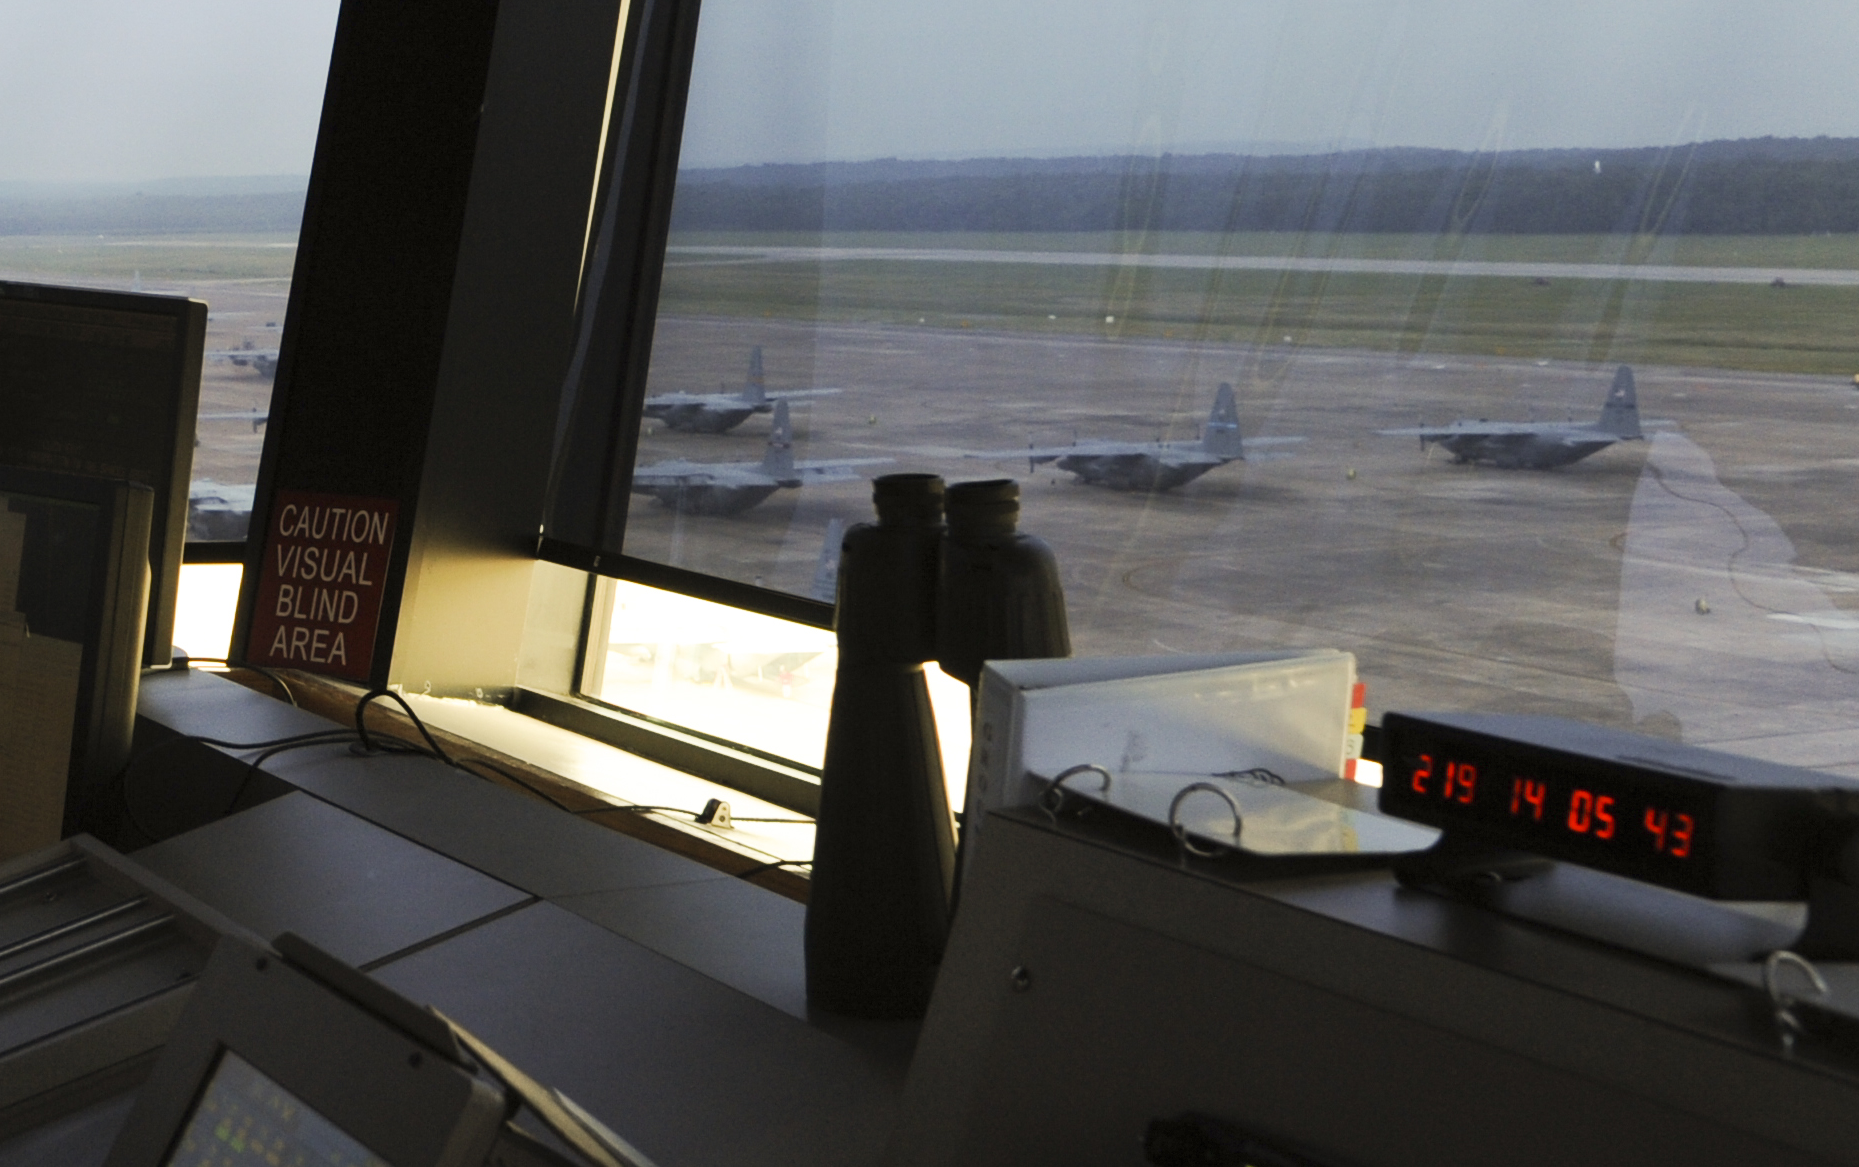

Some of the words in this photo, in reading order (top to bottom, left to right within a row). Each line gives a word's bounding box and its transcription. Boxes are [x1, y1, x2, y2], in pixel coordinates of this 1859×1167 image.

[279, 503, 390, 545] CAUTION
[277, 544, 373, 586] VISUAL
[275, 584, 359, 624] BLIND
[269, 625, 347, 666] AREA
[1411, 753, 1477, 804] 219
[1510, 778, 1546, 821] 14
[1568, 789, 1615, 840] 05
[1644, 807, 1695, 859] 43
